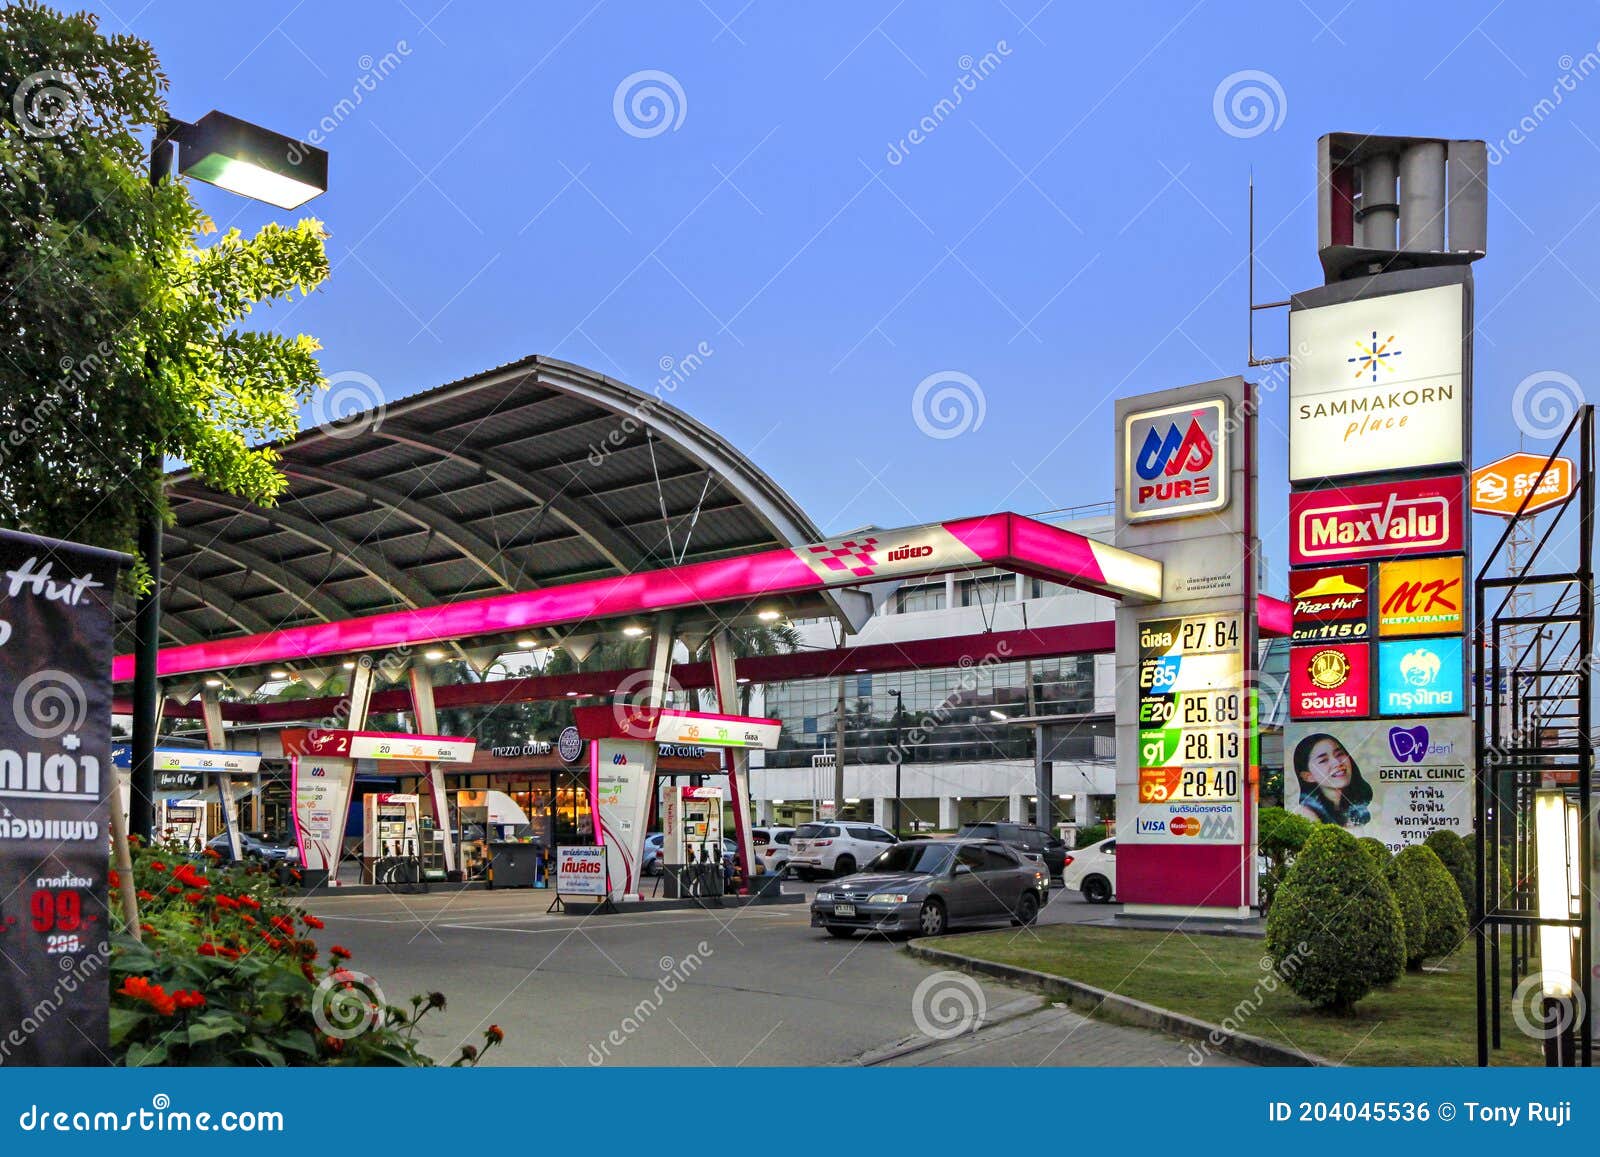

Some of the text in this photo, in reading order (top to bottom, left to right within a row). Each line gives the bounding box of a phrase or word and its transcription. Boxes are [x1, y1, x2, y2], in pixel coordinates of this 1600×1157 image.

[1300, 385, 1454, 420] SAMMAKORN
[1344, 414, 1408, 442] place
[1139, 477, 1210, 504] PURE
[1312, 494, 1436, 546] MaxValu
[6, 557, 104, 606] Hut
[1382, 578, 1460, 614] MK
[1294, 598, 1362, 615] Pizza Hut
[1382, 614, 1460, 624] RESTAURANTS
[1141, 620, 1239, 650] ดีเซล 27.64
[1293, 623, 1367, 639] Call 1150
[1140, 665, 1177, 688] E85
[1301, 693, 1357, 709] ออมสิน
[1389, 688, 1453, 709] กรุงไทย
[1140, 694, 1239, 723] E20 25.89
[336, 737, 347, 752] 2
[492, 743, 550, 757] mezzo coffee
[1143, 732, 1239, 766] 91 28.13
[1428, 741, 1454, 754] dent
[1380, 768, 1465, 779] DENTAL CLINIC
[1142, 770, 1237, 800] 95 28.40
[1409, 786, 1445, 799] ทำฟัน
[1409, 800, 1445, 812] จัดฟัน
[1142, 821, 1165, 831] VISA
[1394, 814, 1460, 826] ฟอกฟันขาว
[561, 857, 601, 873] เต็มลิตร
[36, 869, 93, 888] ถาดที่สอง
